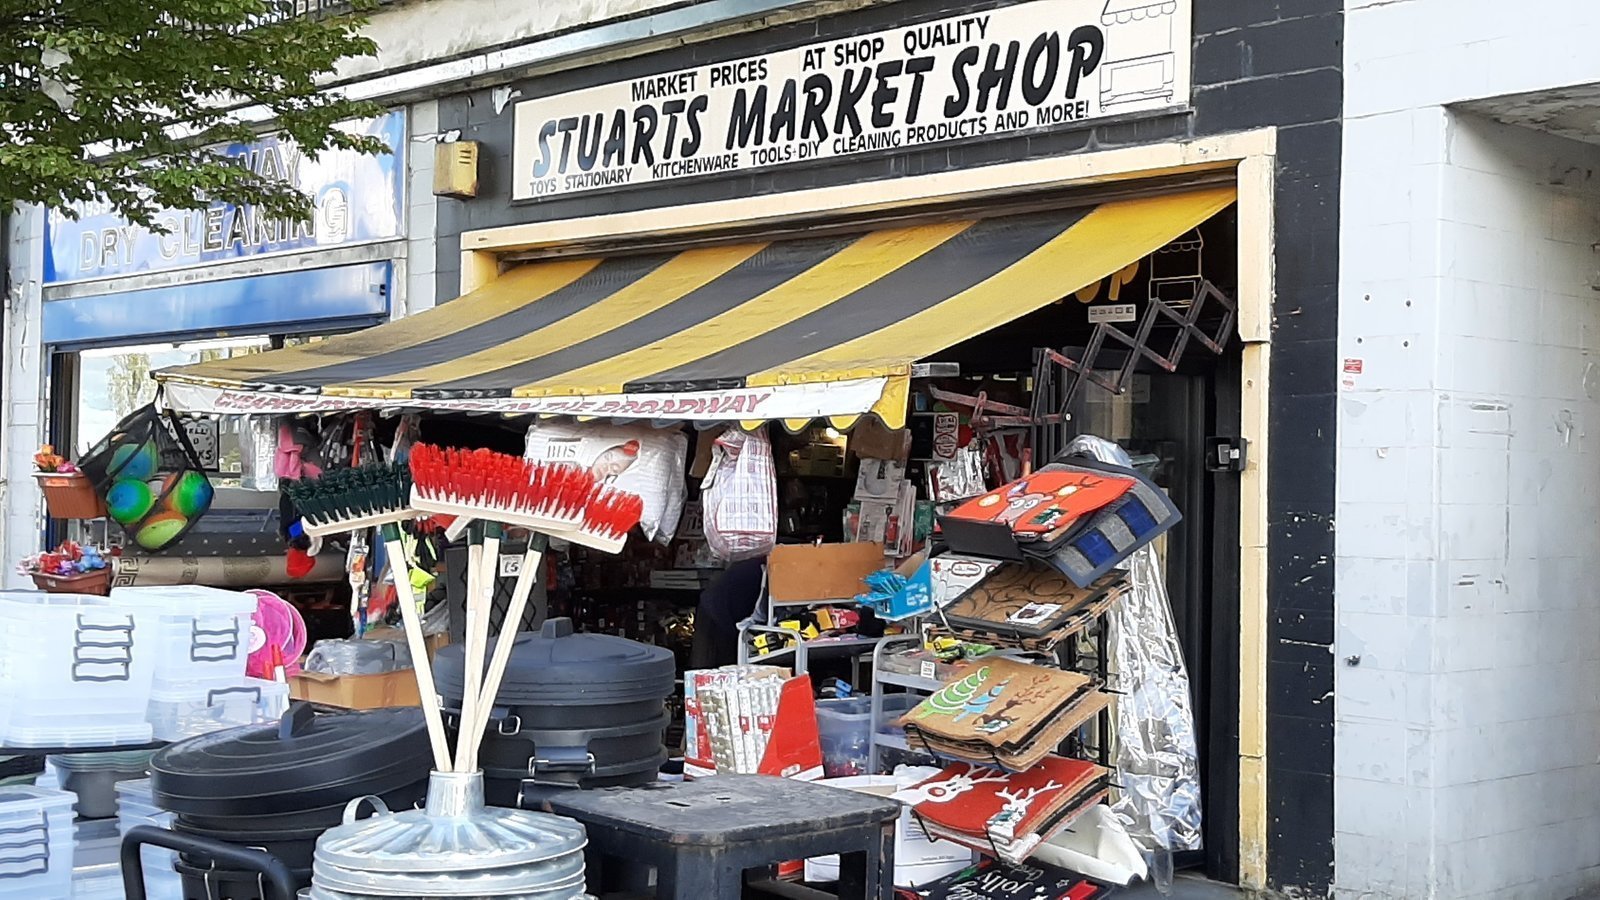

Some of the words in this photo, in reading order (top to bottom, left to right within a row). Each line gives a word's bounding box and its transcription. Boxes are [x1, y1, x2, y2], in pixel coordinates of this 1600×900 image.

[532, 94, 709, 178] STUARTS
[725, 56, 936, 150] MARKET
[943, 25, 1104, 119] SHOP
[631, 71, 697, 102] MARKET
[710, 58, 768, 88] PRICES
[802, 47, 826, 72] AT
[834, 37, 885, 67] SHOP
[903, 15, 990, 56] QUALITY
[529, 177, 557, 196] TOYS
[564, 167, 633, 191] STATIONARY
[652, 153, 739, 179] KITCHENWARE
[833, 130, 901, 154] CLEANING
[906, 116, 988, 144] PRODUCTS
[994, 111, 1029, 132] AND
[1036, 100, 1090, 126] MORE!
[80, 225, 140, 271] DRY
[158, 188, 349, 261] CLEANING
[592, 393, 771, 414] BROADWAY
